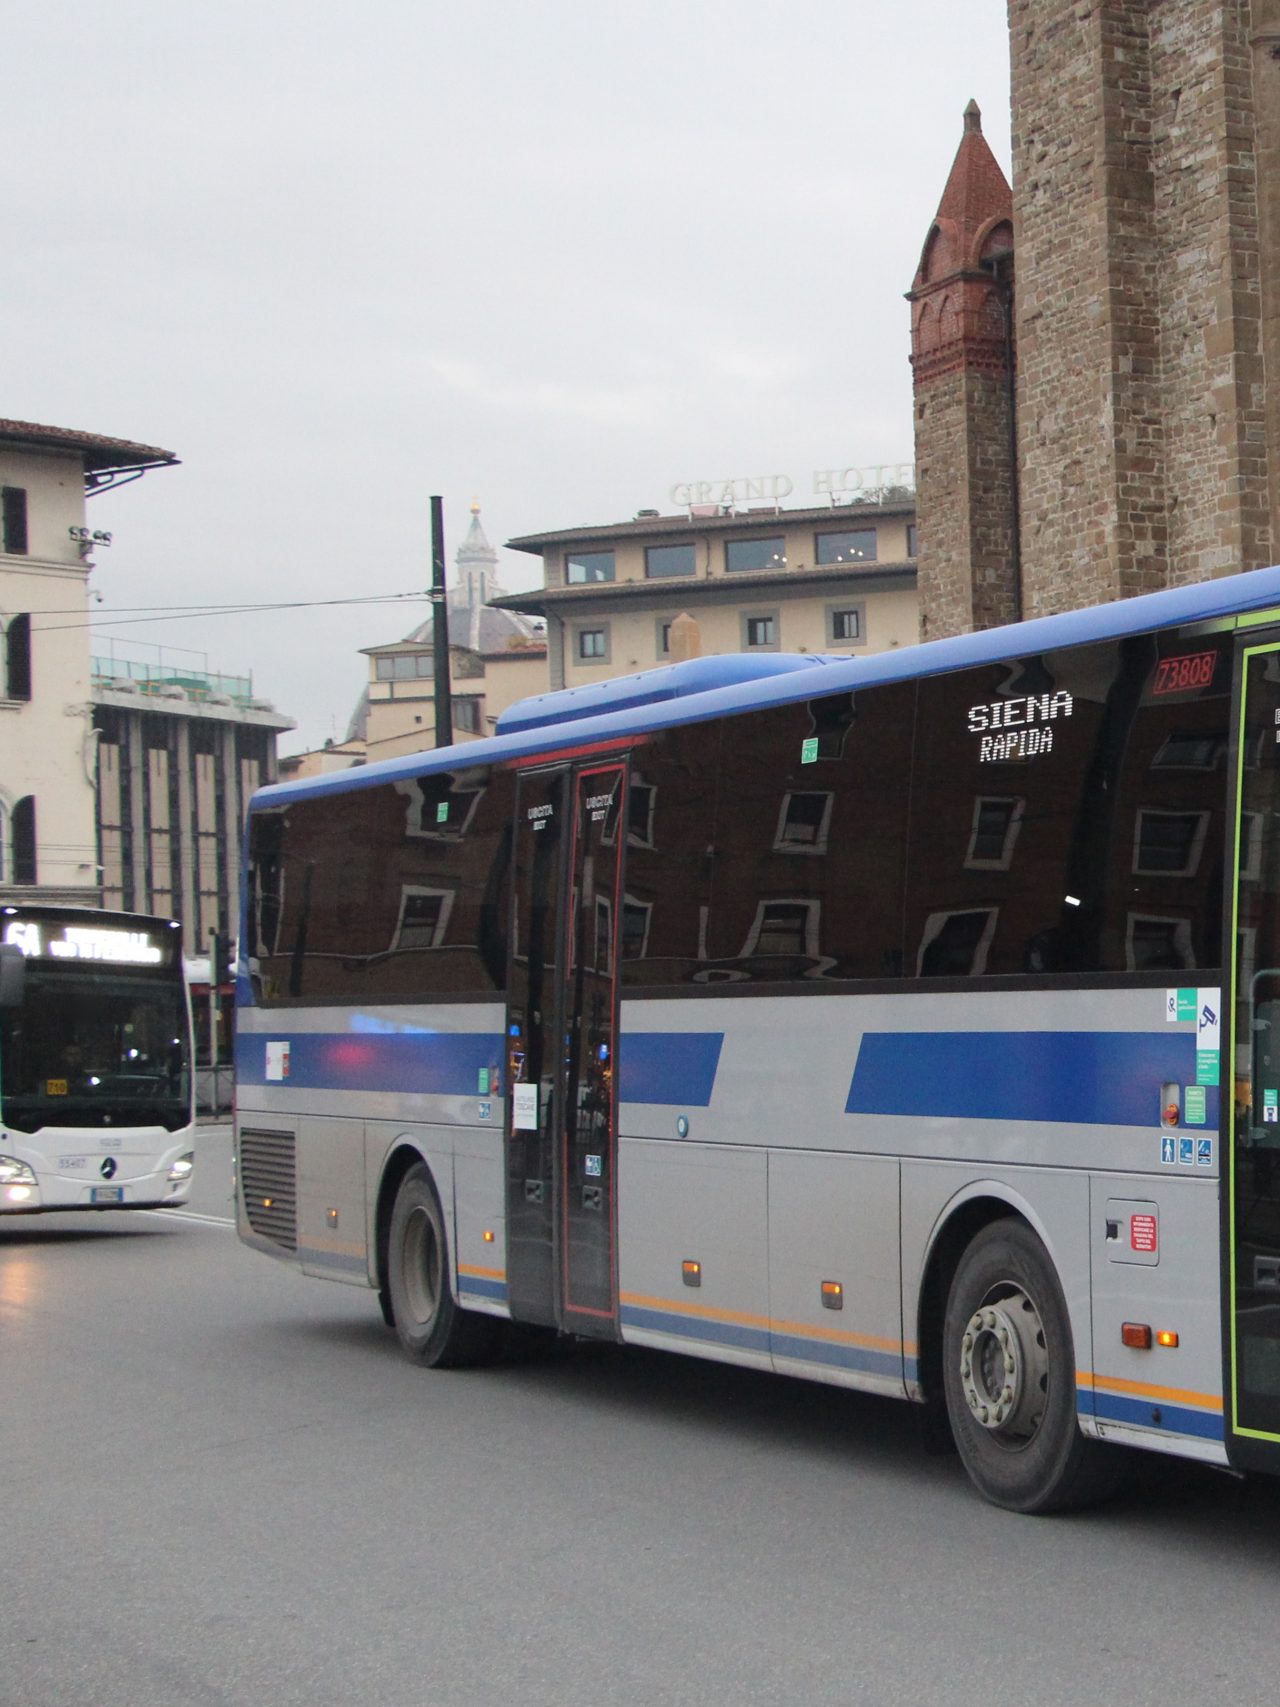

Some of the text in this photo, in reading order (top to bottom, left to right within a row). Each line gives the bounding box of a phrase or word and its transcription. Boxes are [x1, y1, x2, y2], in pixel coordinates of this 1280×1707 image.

[669, 474, 794, 507] GRAND
[1156, 655, 1213, 690] 73808
[968, 690, 1073, 732] SIENA
[979, 727, 1053, 762] RAPIDA
